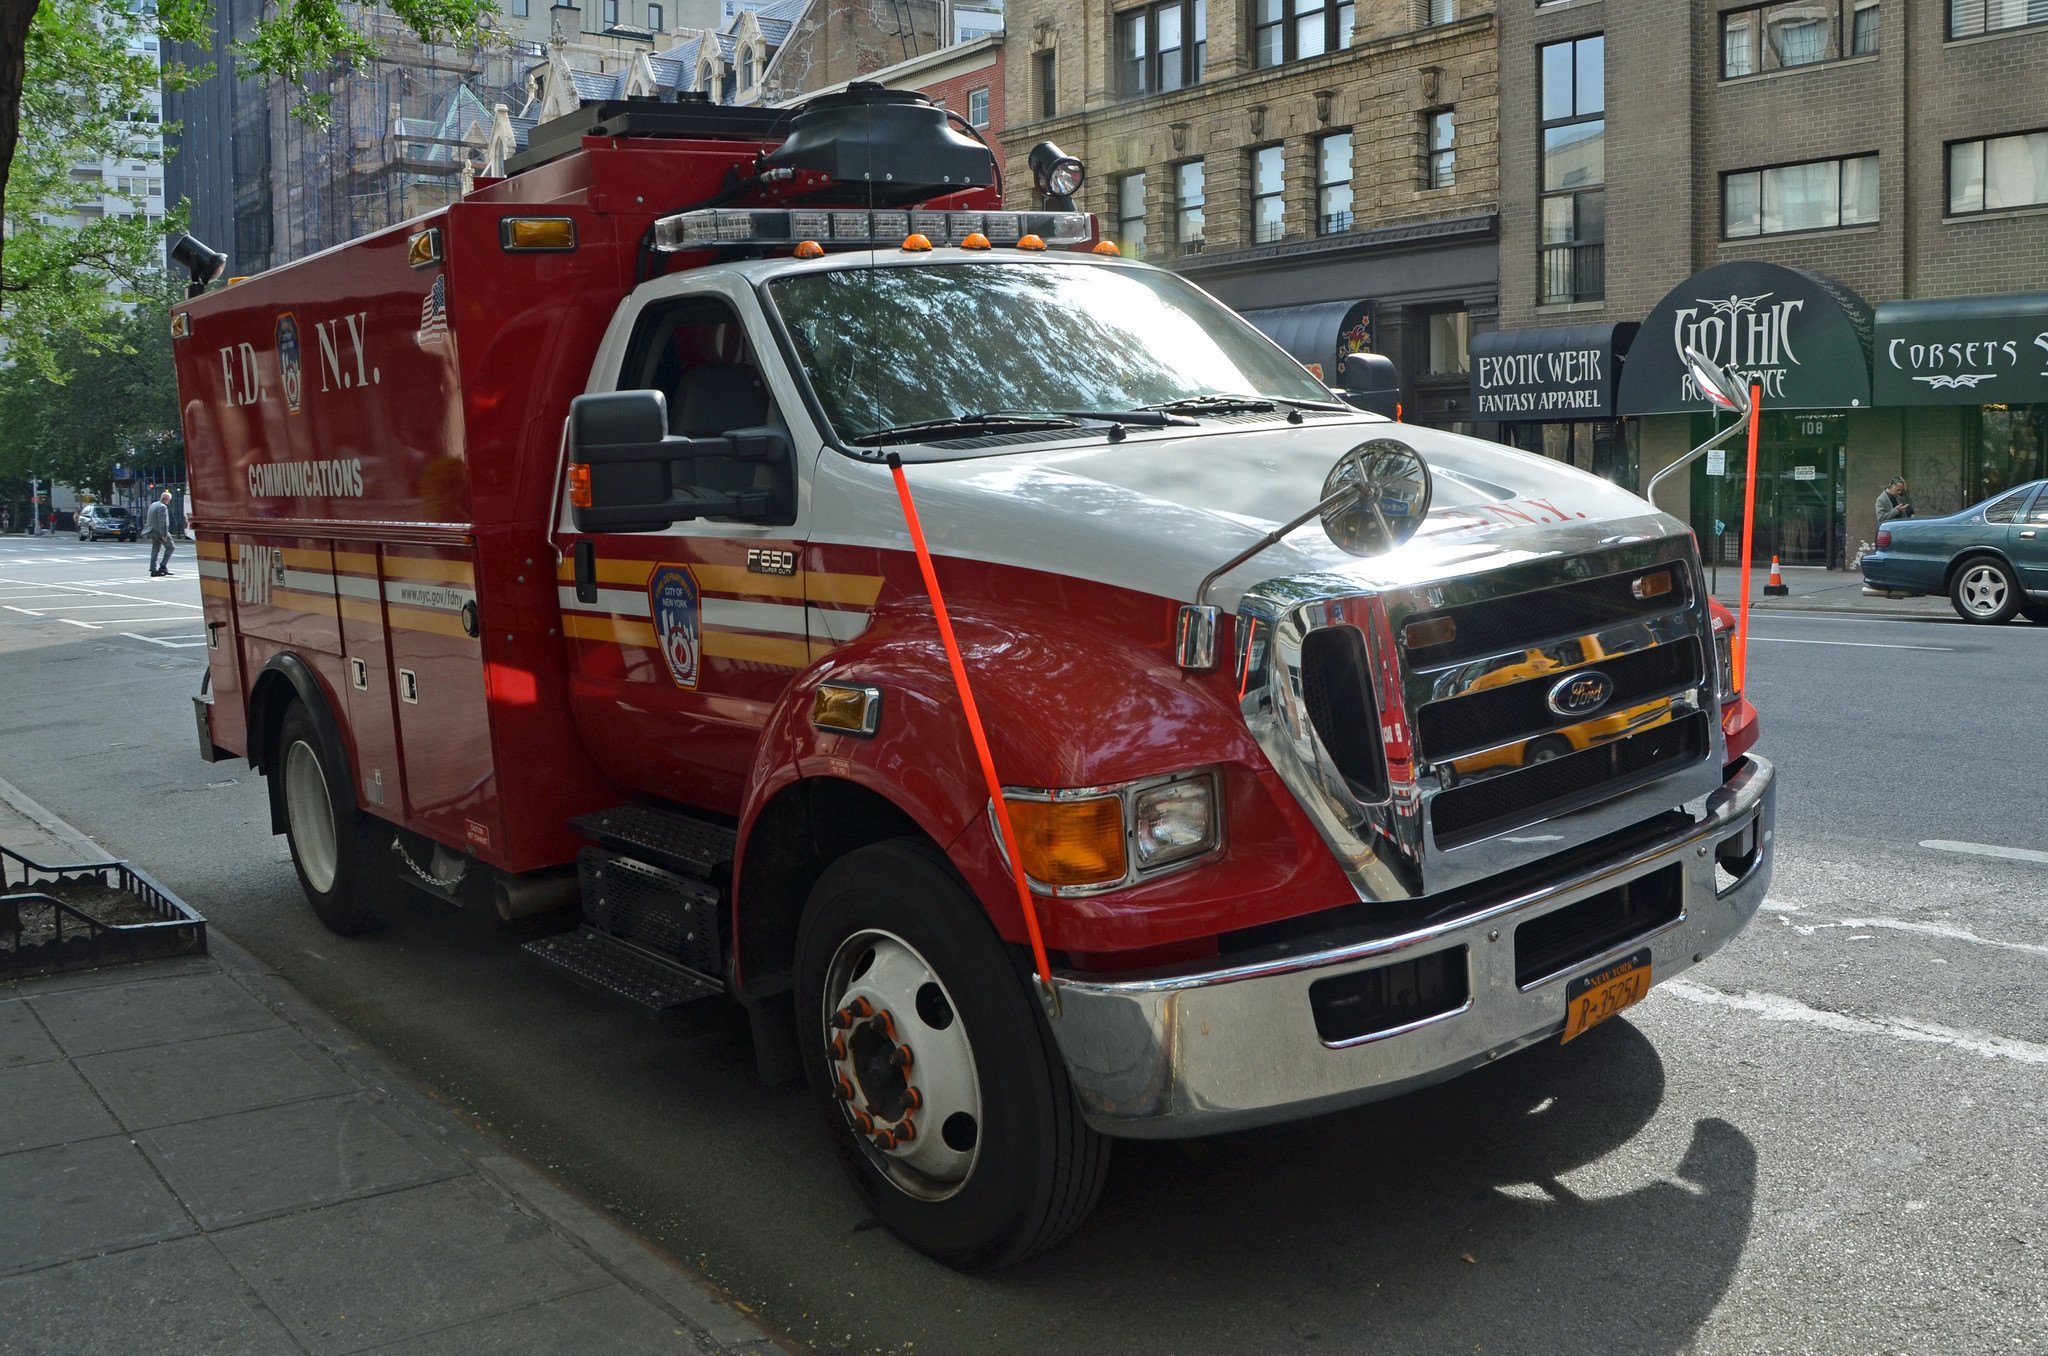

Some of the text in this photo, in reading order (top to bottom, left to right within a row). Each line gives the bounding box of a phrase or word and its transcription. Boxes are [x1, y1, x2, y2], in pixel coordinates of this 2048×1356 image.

[1674, 293, 1804, 366] GOTHIC
[219, 342, 267, 408] F.D.
[315, 312, 380, 392] N.Y.
[1888, 338, 2018, 369] CORSETS
[1479, 350, 1602, 389] EXOTIC WEAR
[1478, 389, 1602, 412] FANTASY APPAREL
[1801, 421, 1823, 435] 108
[248, 458, 364, 497] COMMUNICATIONS
[238, 543, 272, 605] FDNY
[400, 588, 464, 609] www.nyc.gov/fdny
[662, 598, 688, 609] NEW YORK
[665, 587, 684, 597] CITY OF
[1569, 680, 1603, 708] Ford
[1590, 961, 1633, 987] NEW YORK
